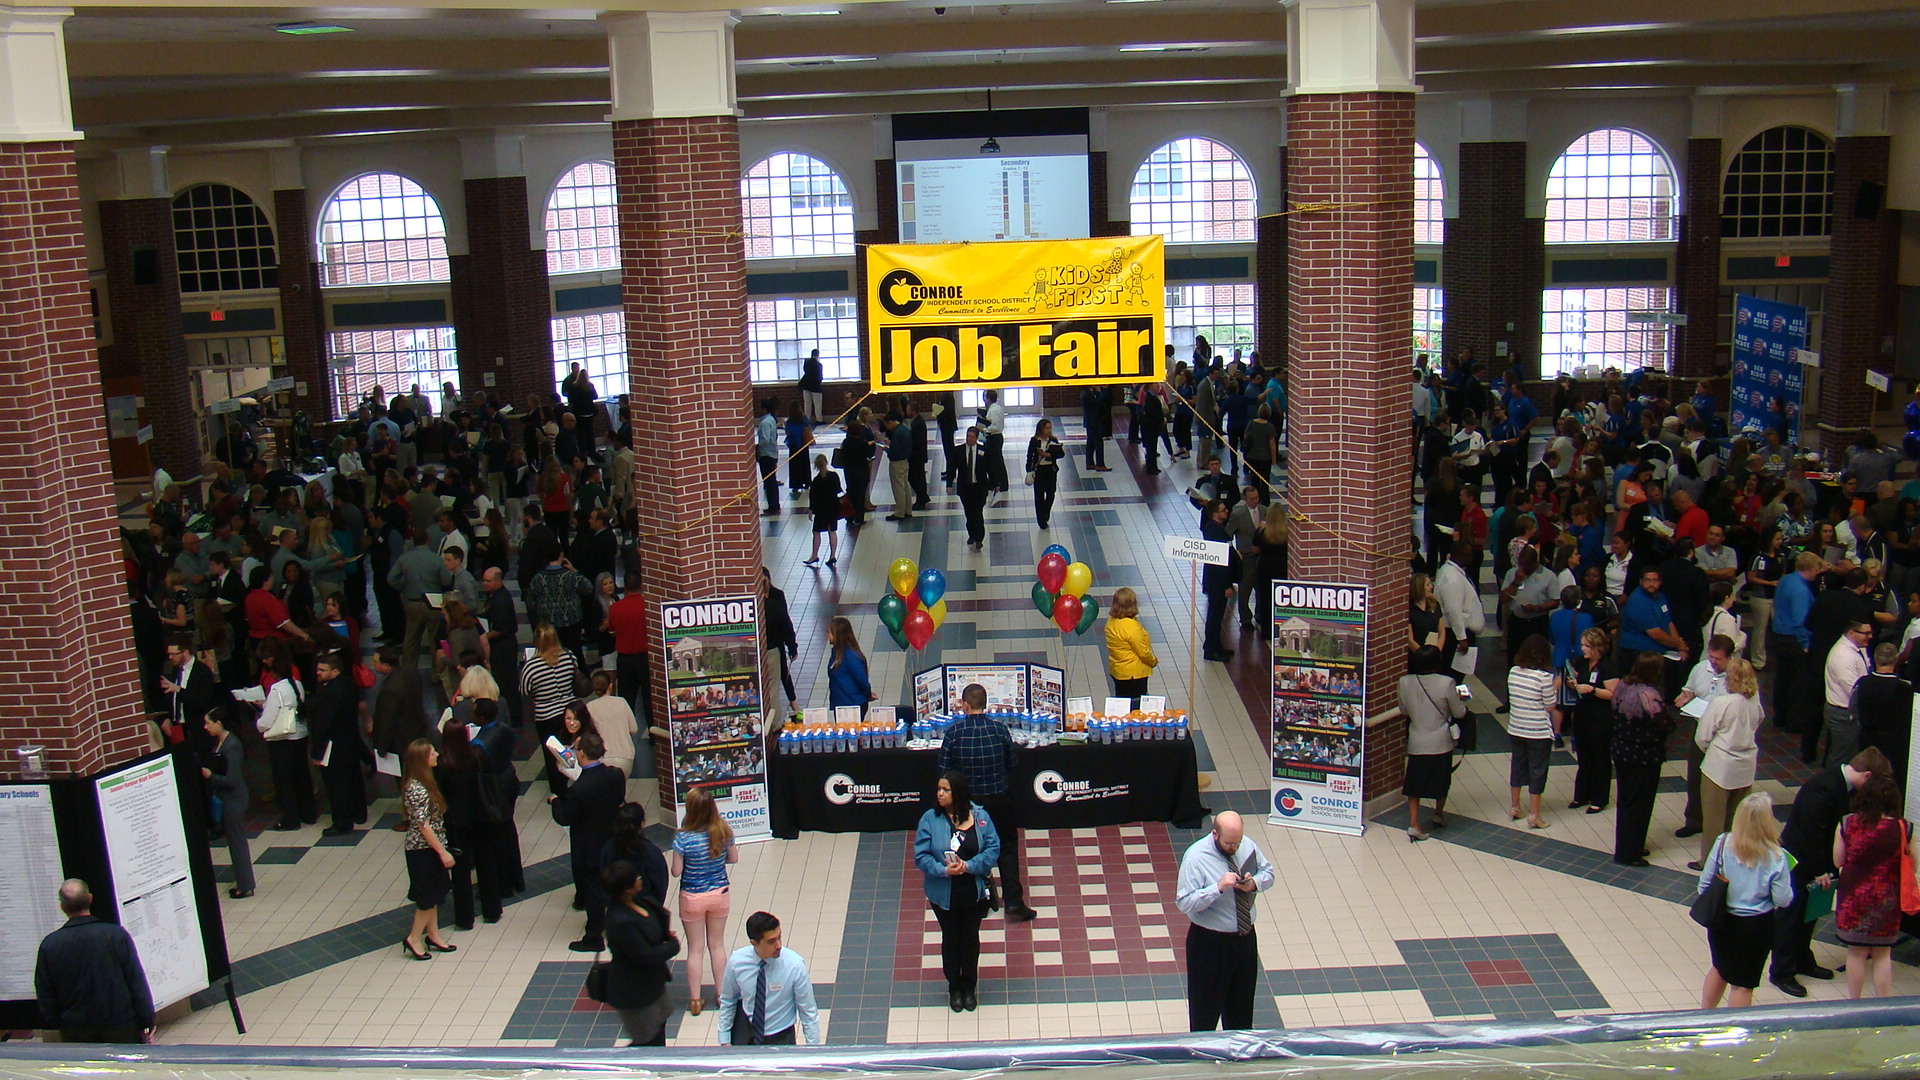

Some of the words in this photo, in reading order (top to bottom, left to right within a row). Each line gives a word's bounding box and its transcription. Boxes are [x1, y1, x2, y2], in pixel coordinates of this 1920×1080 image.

[910, 285, 963, 299] CONROE
[938, 307, 975, 315] Committed
[884, 327, 1003, 382] Job
[1019, 322, 1150, 378] Fair
[1184, 540, 1206, 550] CISD
[1172, 548, 1220, 562] Information
[1275, 586, 1364, 610] CONROE
[664, 602, 754, 628] CONROE
[668, 627, 707, 636] Independent
[1288, 768, 1310, 779] Means
[847, 784, 880, 793] CONROE
[1056, 780, 1089, 790] CONROE
[1311, 796, 1359, 809] CONROE
[1312, 805, 1347, 814] INDEPENDENT
